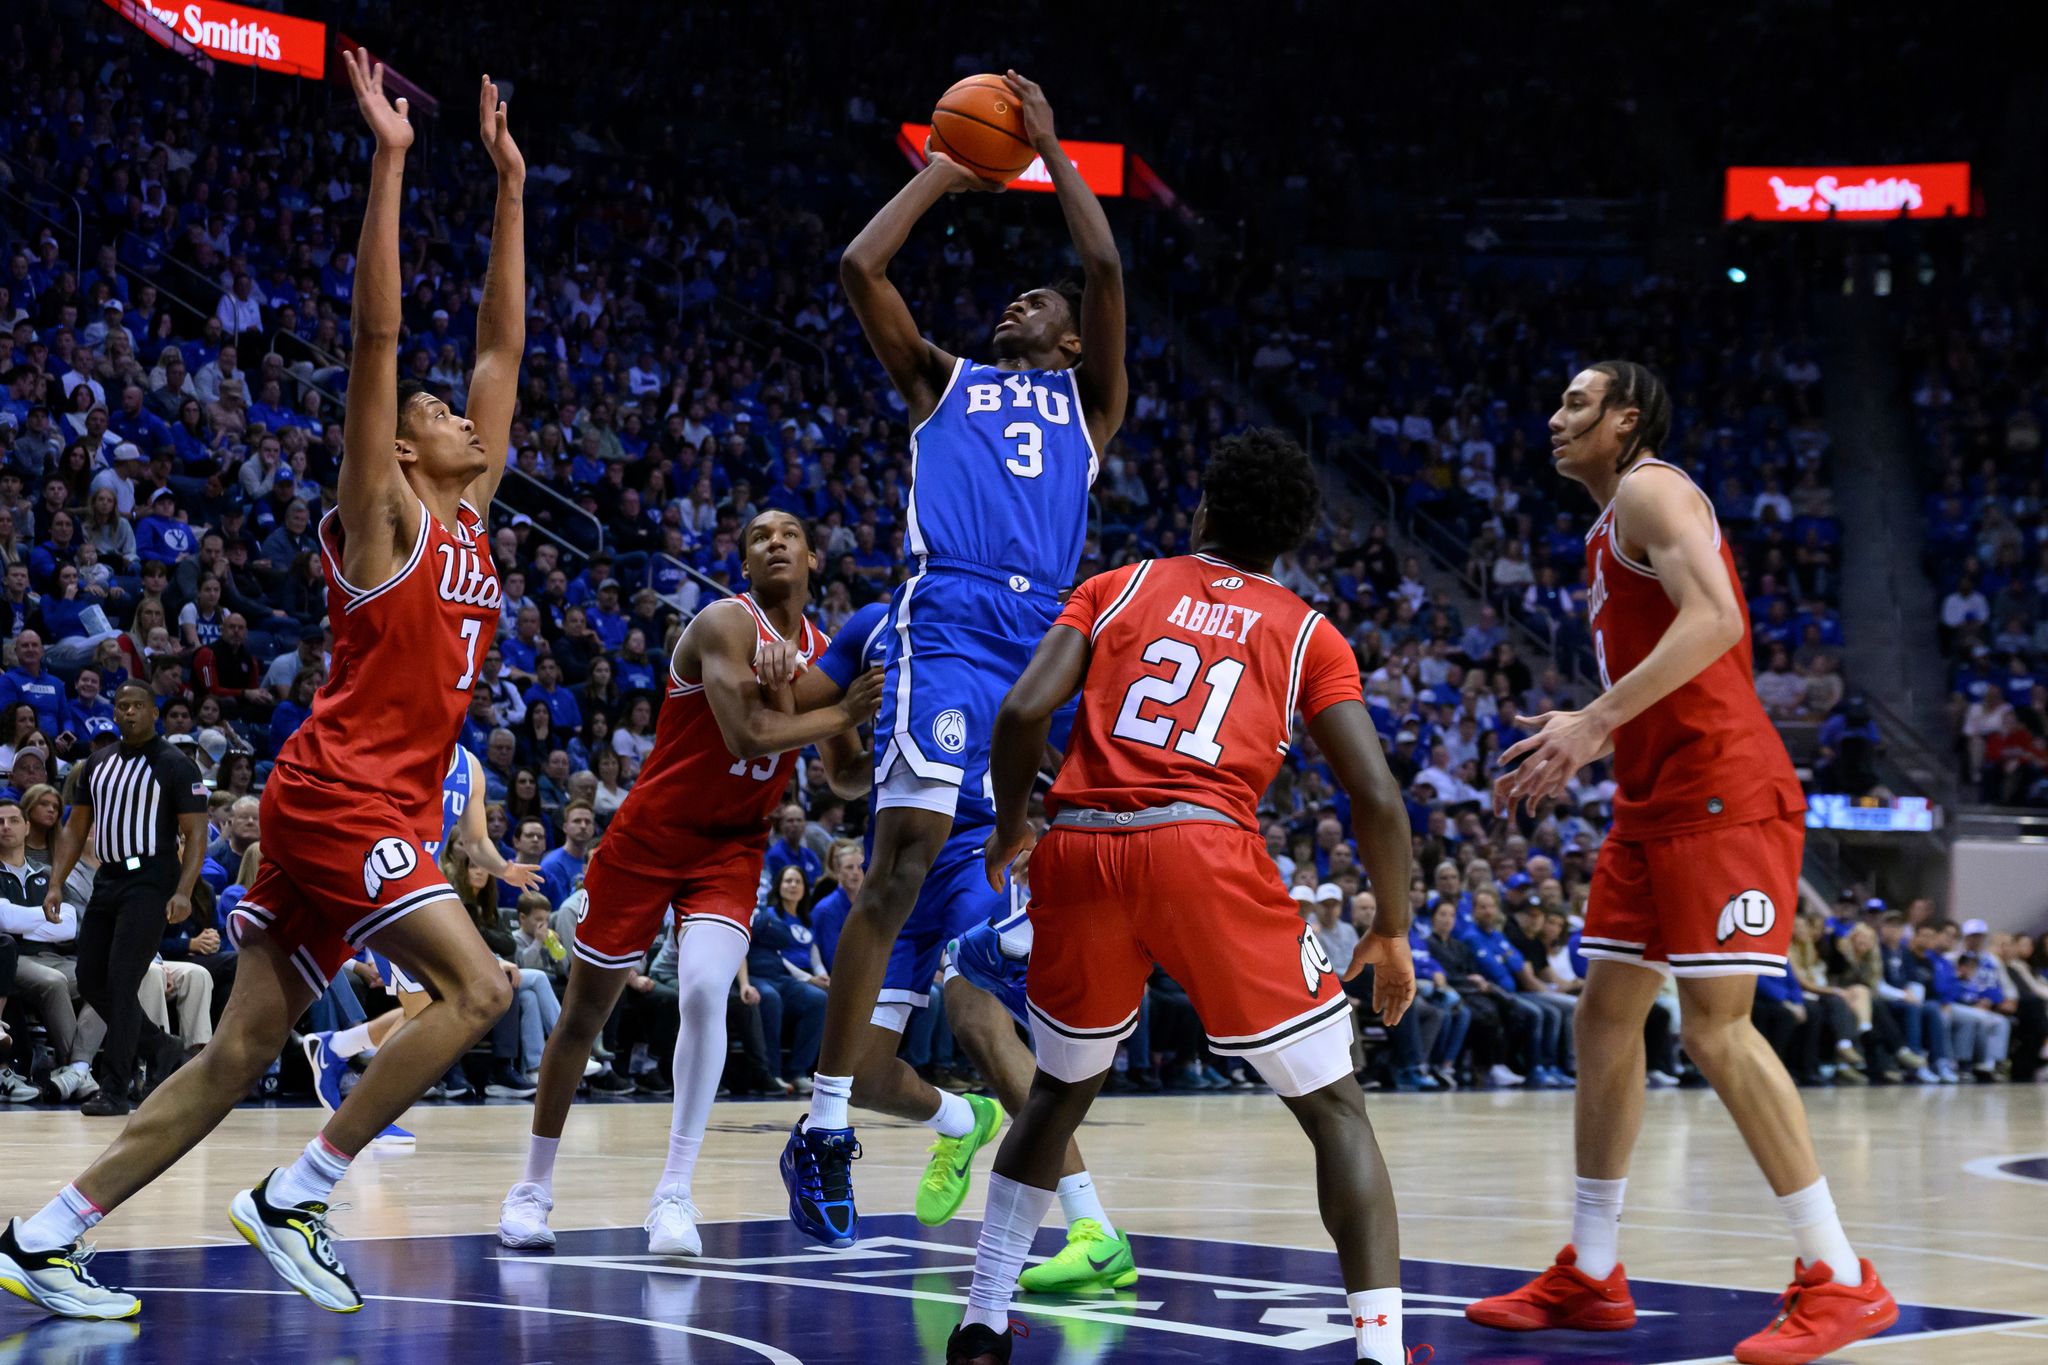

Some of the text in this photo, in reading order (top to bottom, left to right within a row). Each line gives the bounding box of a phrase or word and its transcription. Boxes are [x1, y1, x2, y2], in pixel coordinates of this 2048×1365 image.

[183, 4, 281, 61] Smith's
[966, 374, 1071, 425] BYU
[1003, 421, 1044, 479] 3
[438, 543, 502, 609] Uta
[1167, 595, 1262, 645] ABBEY
[455, 617, 483, 691] 7
[1112, 636, 1247, 768] 21
[375, 841, 410, 875] U
[1741, 898, 1767, 928] U
